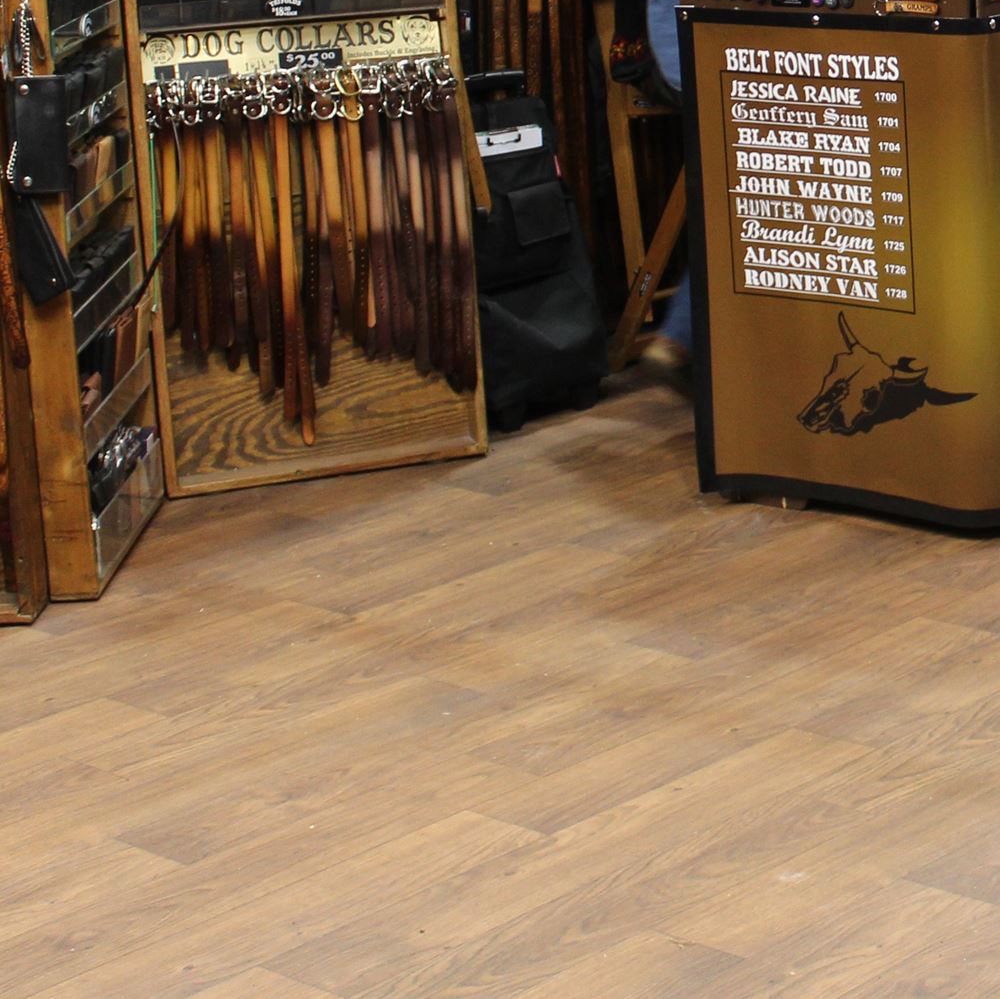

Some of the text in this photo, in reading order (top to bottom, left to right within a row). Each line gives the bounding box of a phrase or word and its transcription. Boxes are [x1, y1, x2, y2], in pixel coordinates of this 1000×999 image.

[181, 20, 396, 59] DOG COLLARS
[725, 48, 900, 81] BELT FONT STYLES
[731, 80, 897, 105] JESSICA RAINE 1700
[823, 108, 868, 128] Sam
[877, 117, 899, 127] 1701
[737, 127, 901, 154] BLAKE RYAN 1704
[735, 151, 903, 178] ROBERT TODD 1707
[735, 175, 904, 204] JOHN WAYNE 1709
[735, 197, 905, 227] HUNTER WOODS 1717
[741, 219, 905, 253] Brandi Lynn 1725
[744, 246, 907, 276] ALISON STAR 1726
[744, 269, 908, 300] RODNEY VAN 1728
